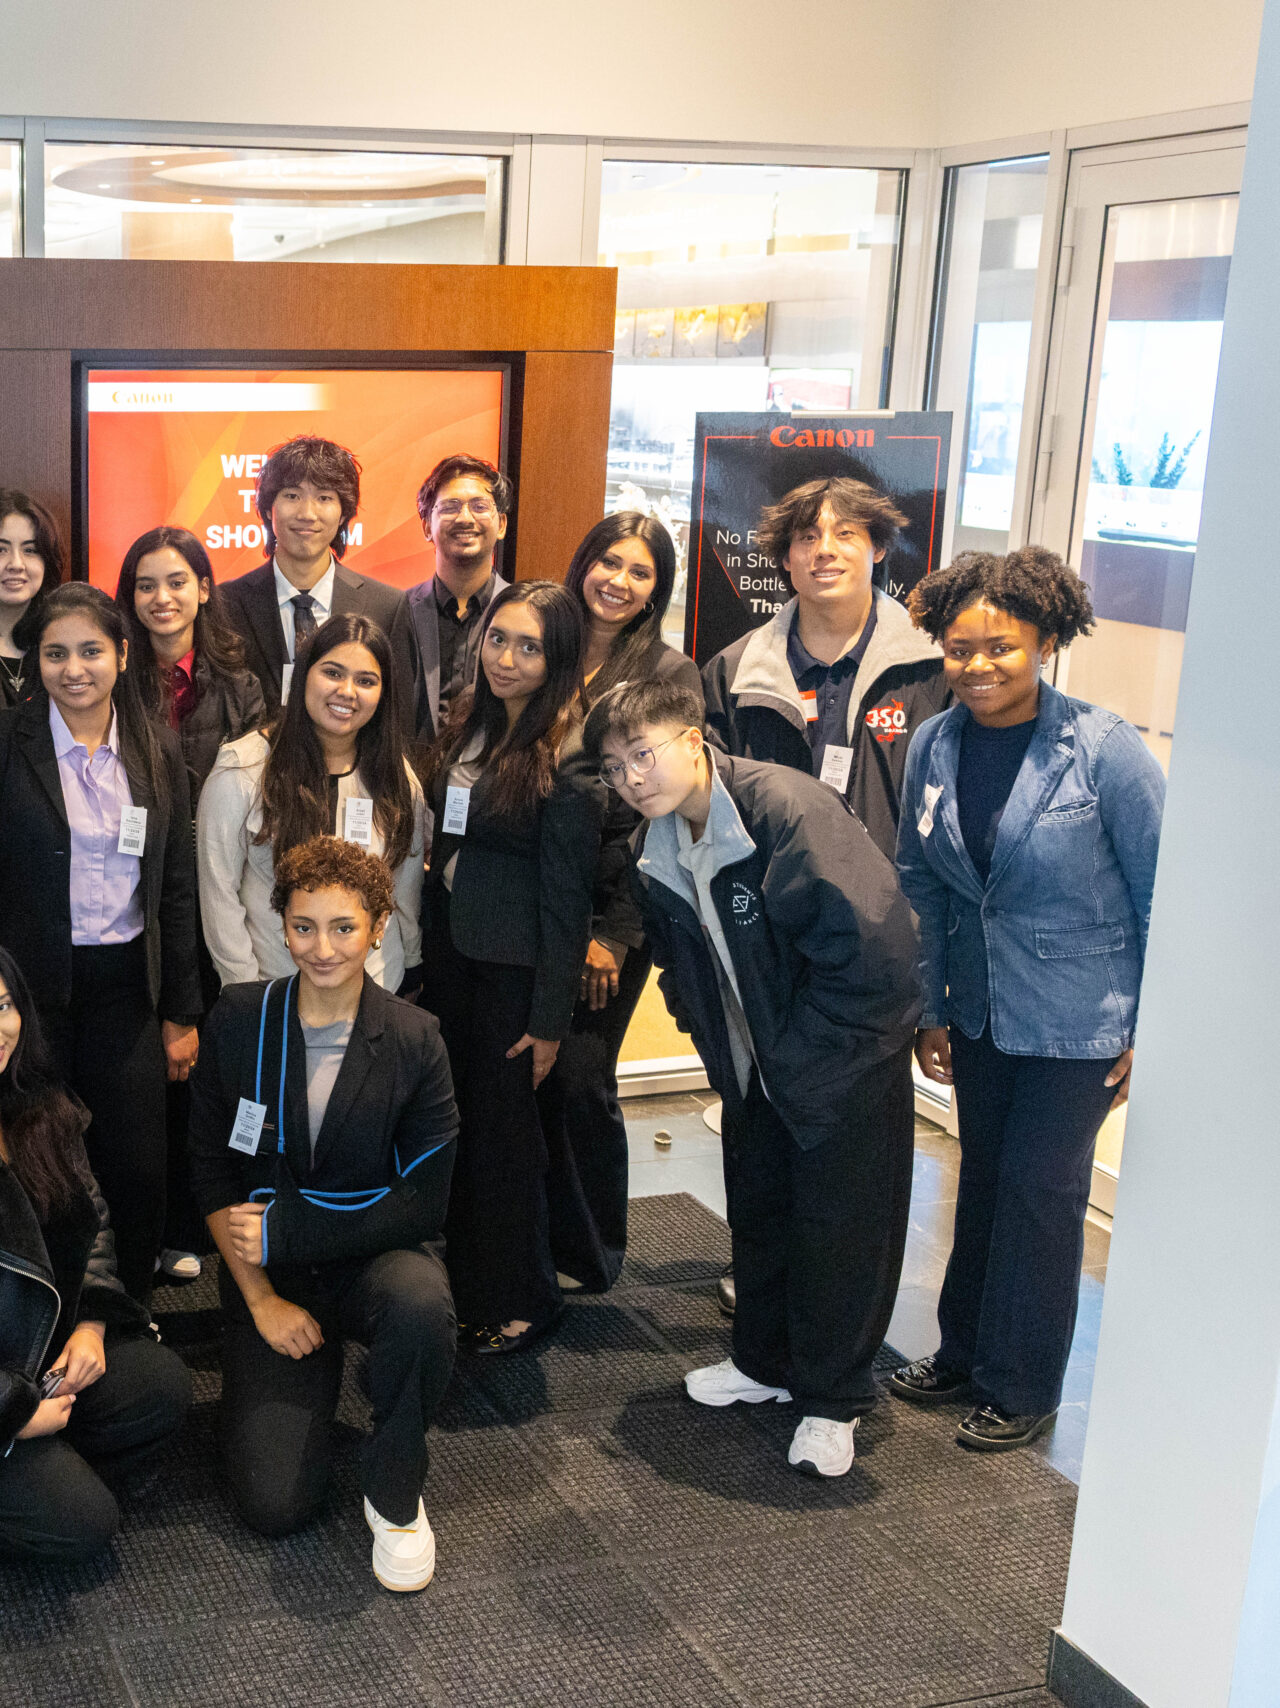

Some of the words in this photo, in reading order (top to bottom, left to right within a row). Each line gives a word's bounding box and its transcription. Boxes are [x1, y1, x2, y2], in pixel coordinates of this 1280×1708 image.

[111, 390, 173, 404] Canon
[770, 425, 875, 448] Canon
[716, 530, 741, 545] No
[727, 553, 741, 568] in
[750, 598, 786, 614] Tha
